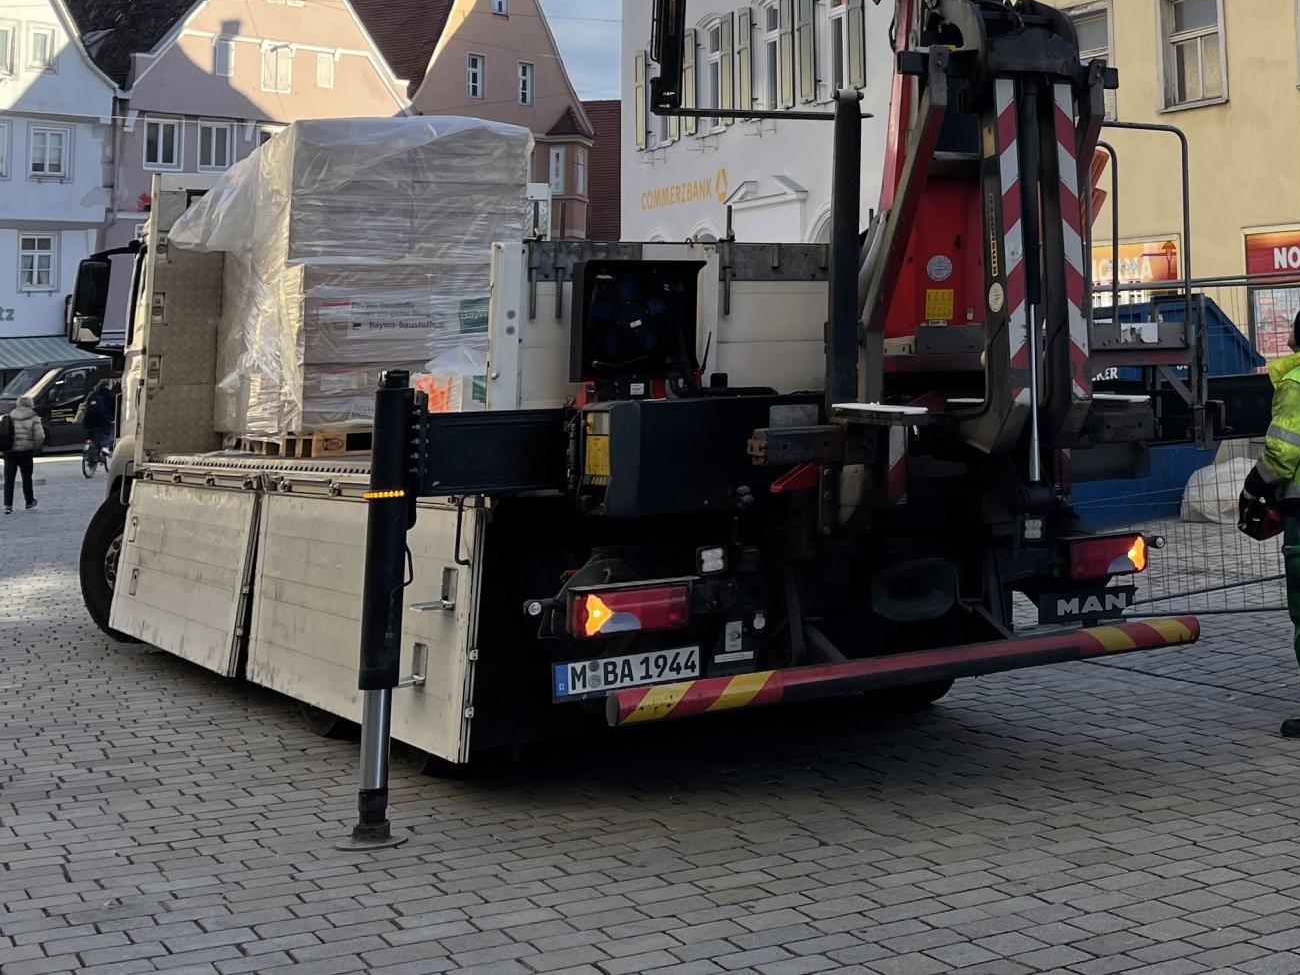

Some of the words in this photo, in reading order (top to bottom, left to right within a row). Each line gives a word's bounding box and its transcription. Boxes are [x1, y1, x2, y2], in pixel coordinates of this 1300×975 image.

[641, 178, 712, 210] COMMERZBANK
[1057, 592, 1127, 616] MAN
[570, 665, 587, 691] M
[603, 659, 634, 686] BA
[639, 650, 697, 681] 1944
